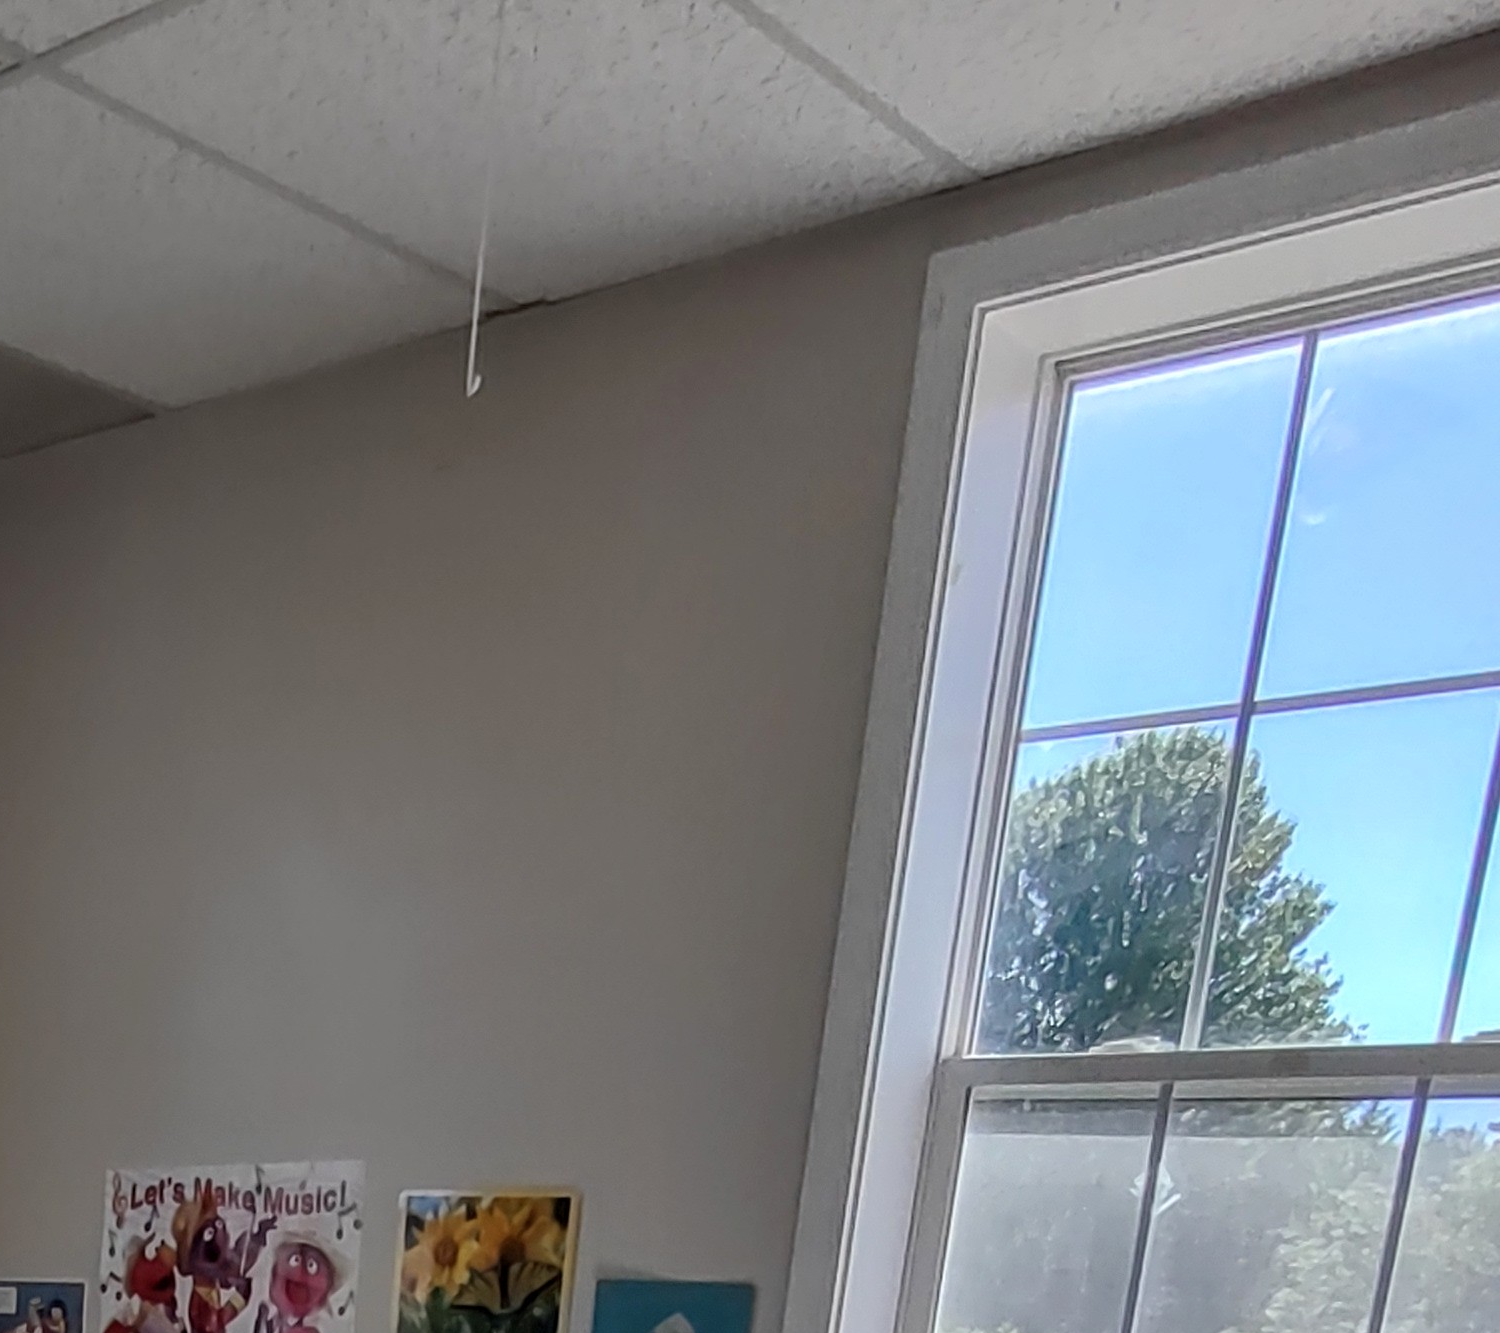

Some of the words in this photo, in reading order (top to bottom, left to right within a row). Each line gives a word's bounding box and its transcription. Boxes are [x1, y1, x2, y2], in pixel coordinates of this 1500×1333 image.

[130, 1176, 186, 1211] Let's
[193, 1176, 258, 1214] Make
[263, 1179, 347, 1217] Music!
